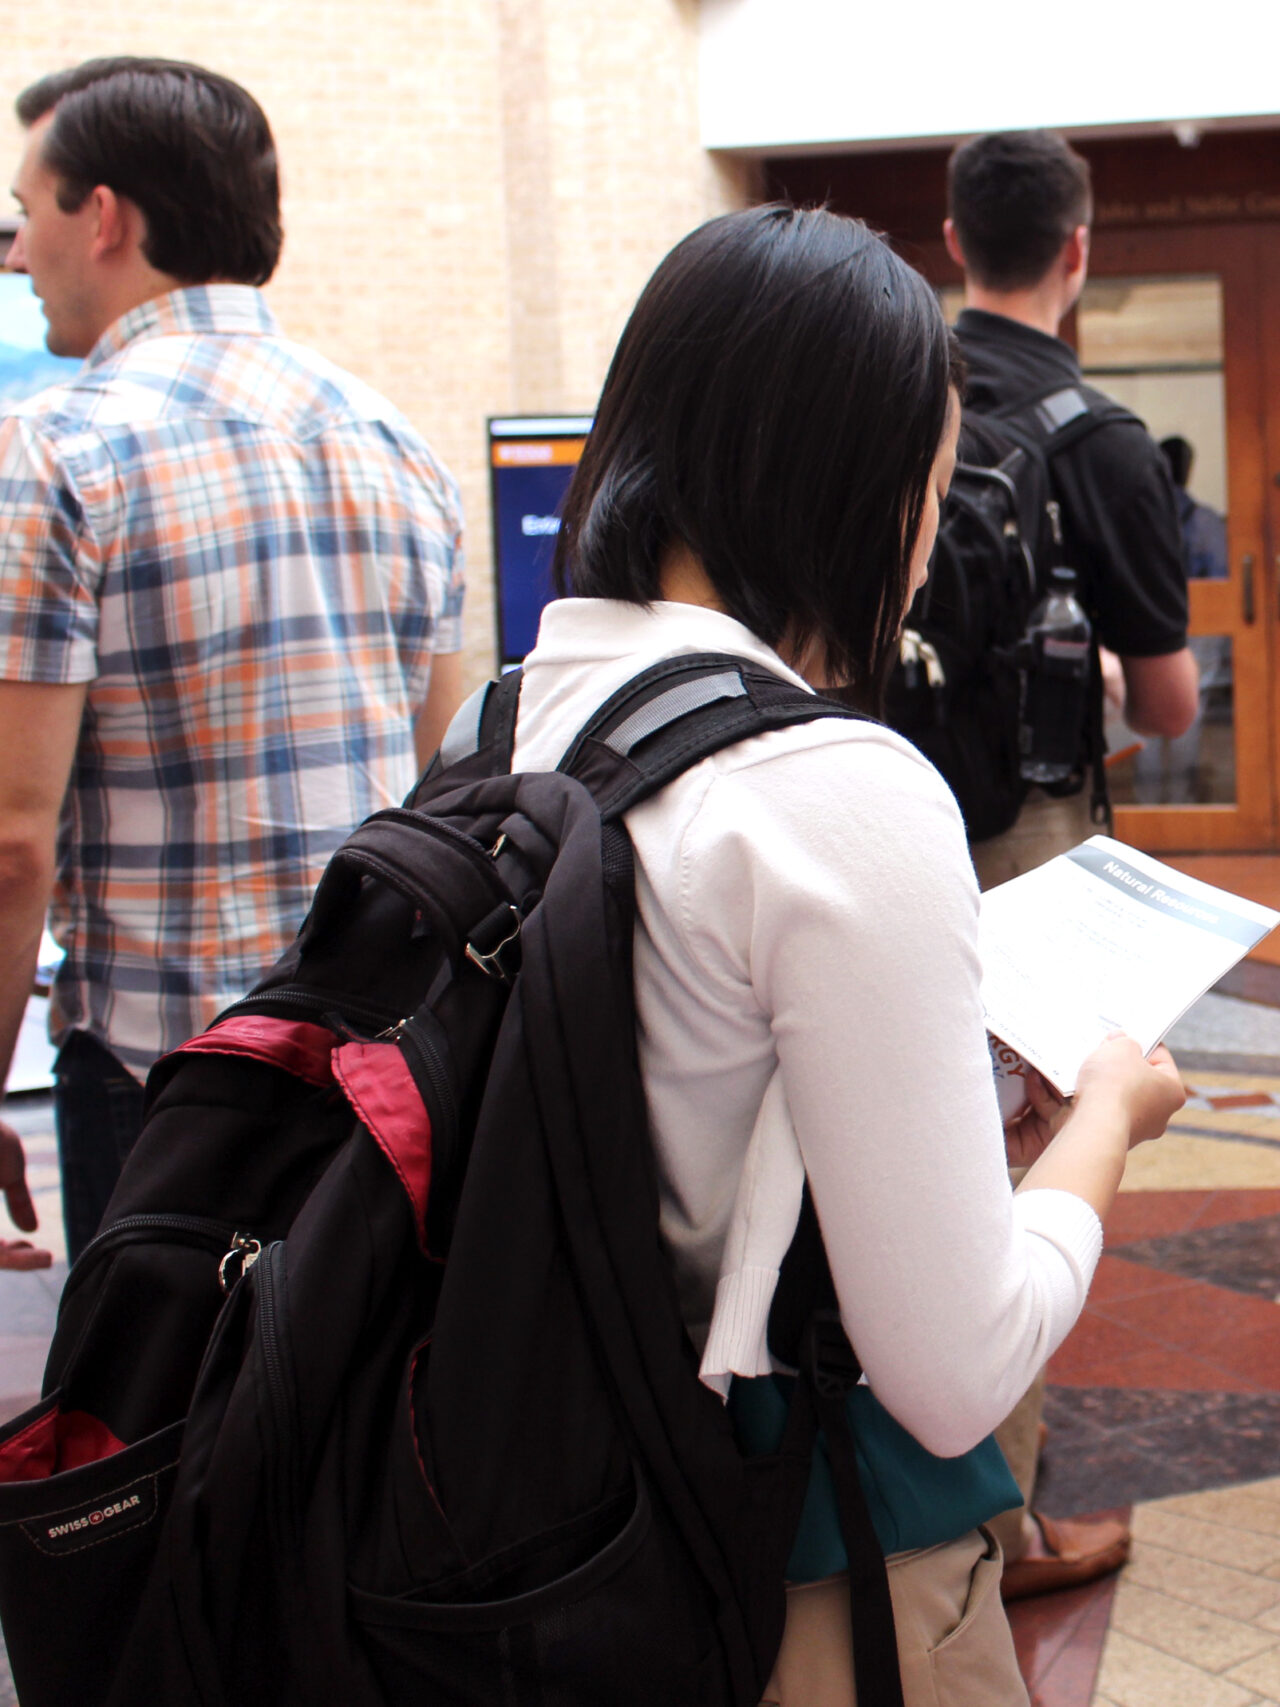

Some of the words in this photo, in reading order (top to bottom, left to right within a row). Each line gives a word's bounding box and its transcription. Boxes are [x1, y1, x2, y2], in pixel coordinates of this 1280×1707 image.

[1103, 861, 1152, 895] Natural
[48, 1517, 89, 1539] SWISS
[103, 1495, 141, 1518] GEAR
